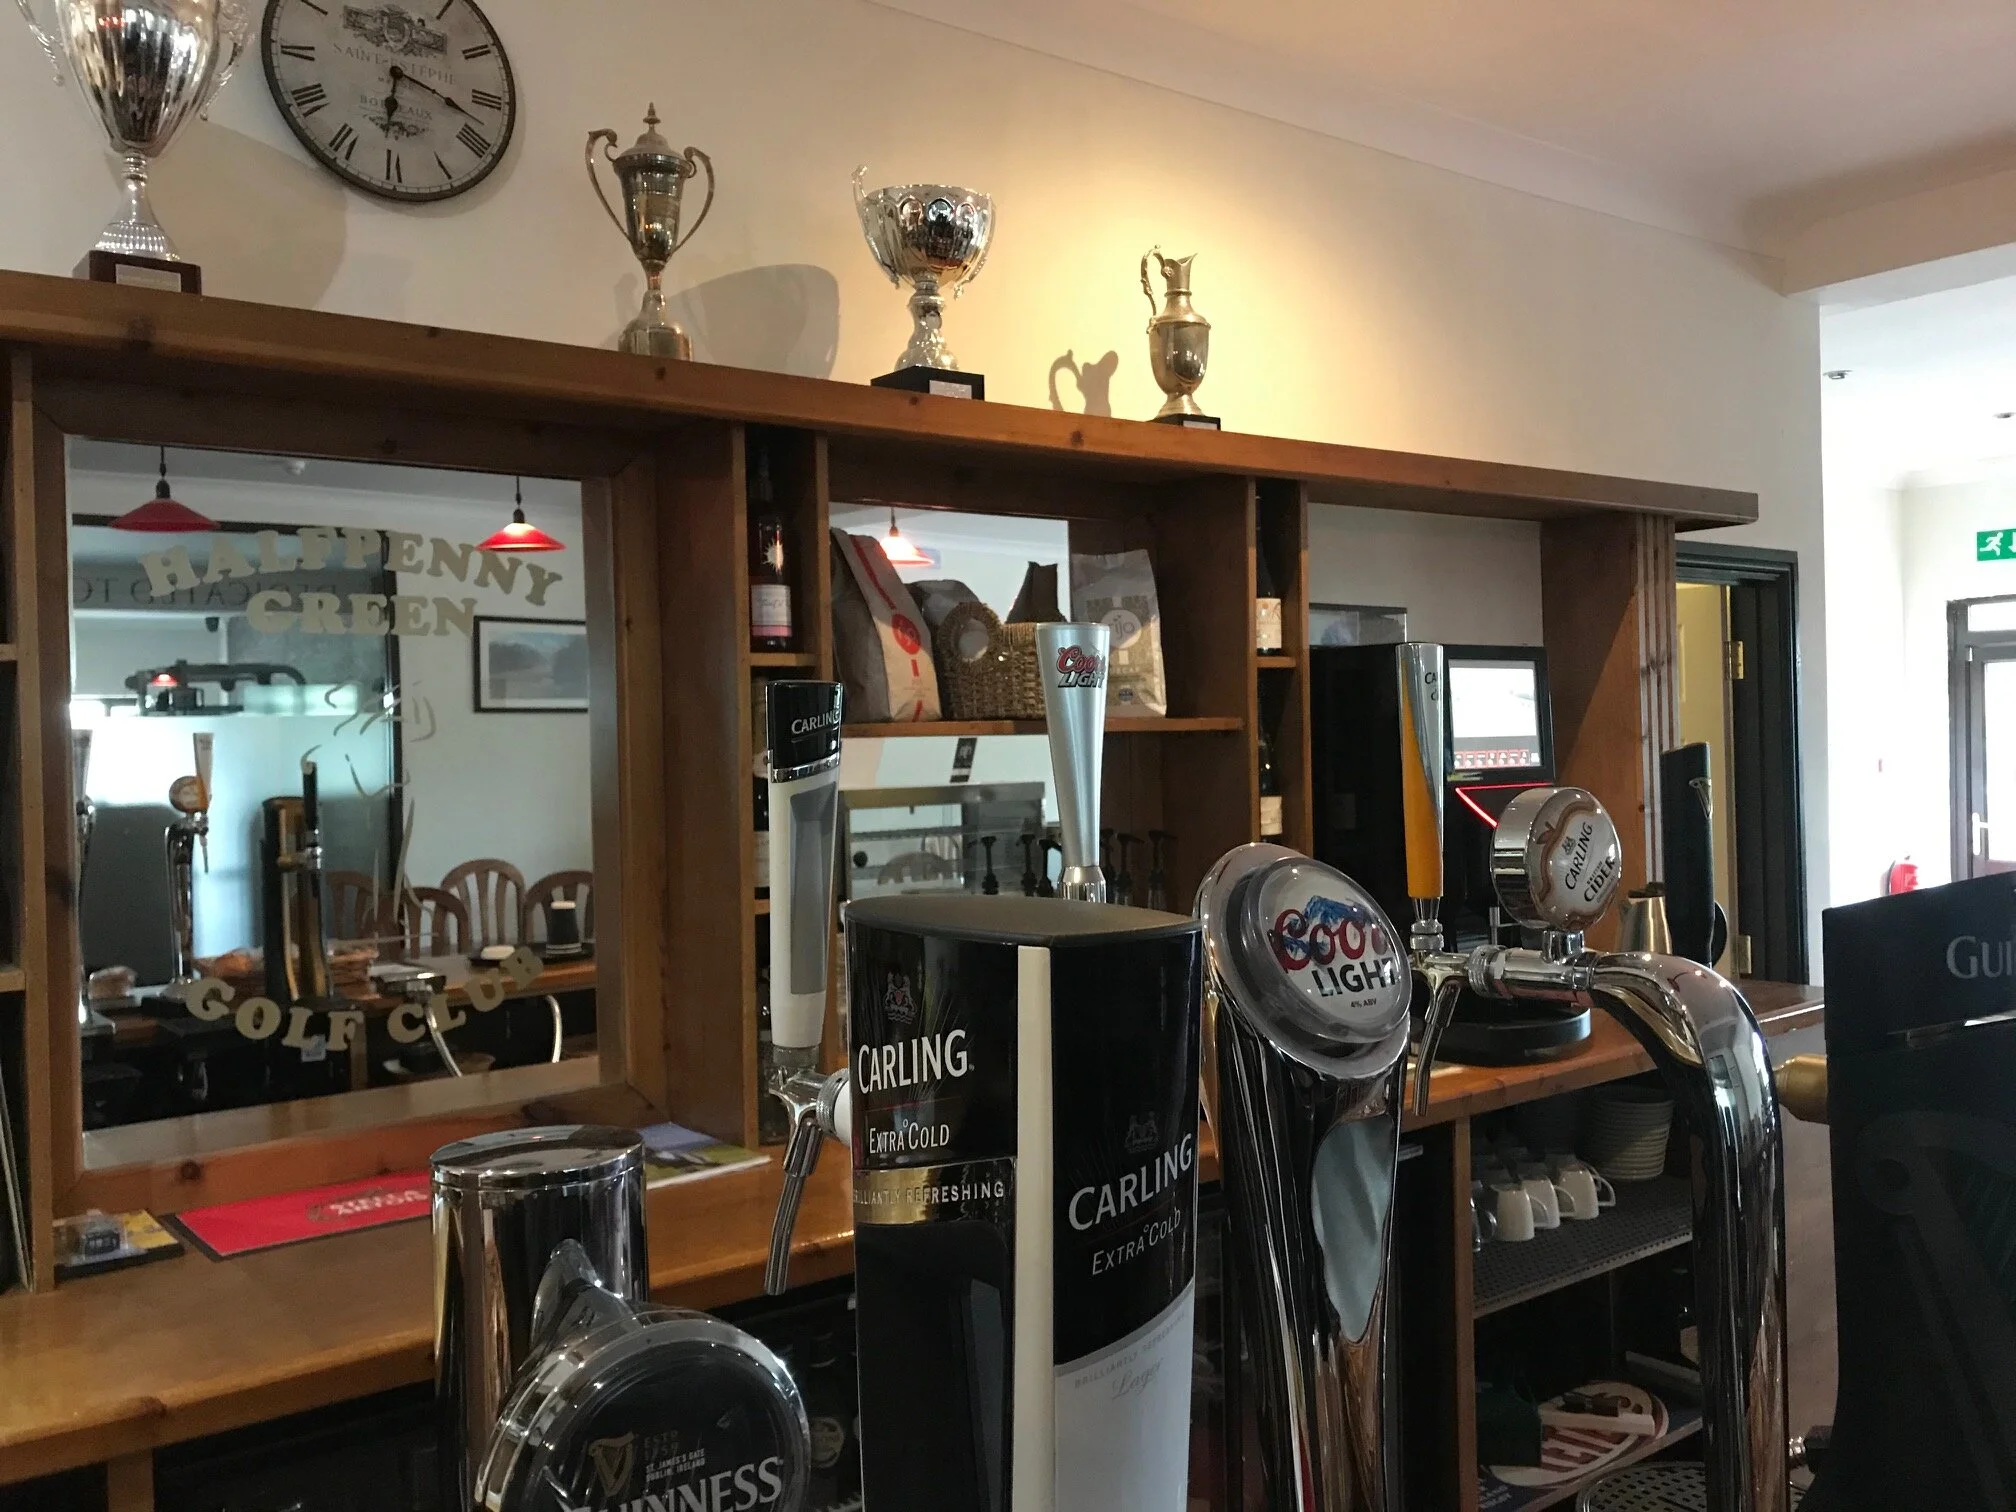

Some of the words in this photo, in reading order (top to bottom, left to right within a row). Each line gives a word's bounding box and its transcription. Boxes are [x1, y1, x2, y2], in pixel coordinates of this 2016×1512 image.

[140, 526, 562, 607] HALFPENNY
[248, 591, 478, 637] GREEN
[791, 710, 841, 734] CARLING
[1565, 822, 1593, 890] CARLING
[1312, 956, 1396, 997] LIGHT
[1946, 935, 2016, 979] GUI
[185, 978, 364, 1051] GOLF
[388, 947, 544, 1044] CLUB
[858, 1029, 968, 1094] CARLING
[906, 1181, 1004, 1204] REFRESHING
[1068, 1133, 1192, 1231] CARLING
[571, 1456, 782, 1512] NESS
